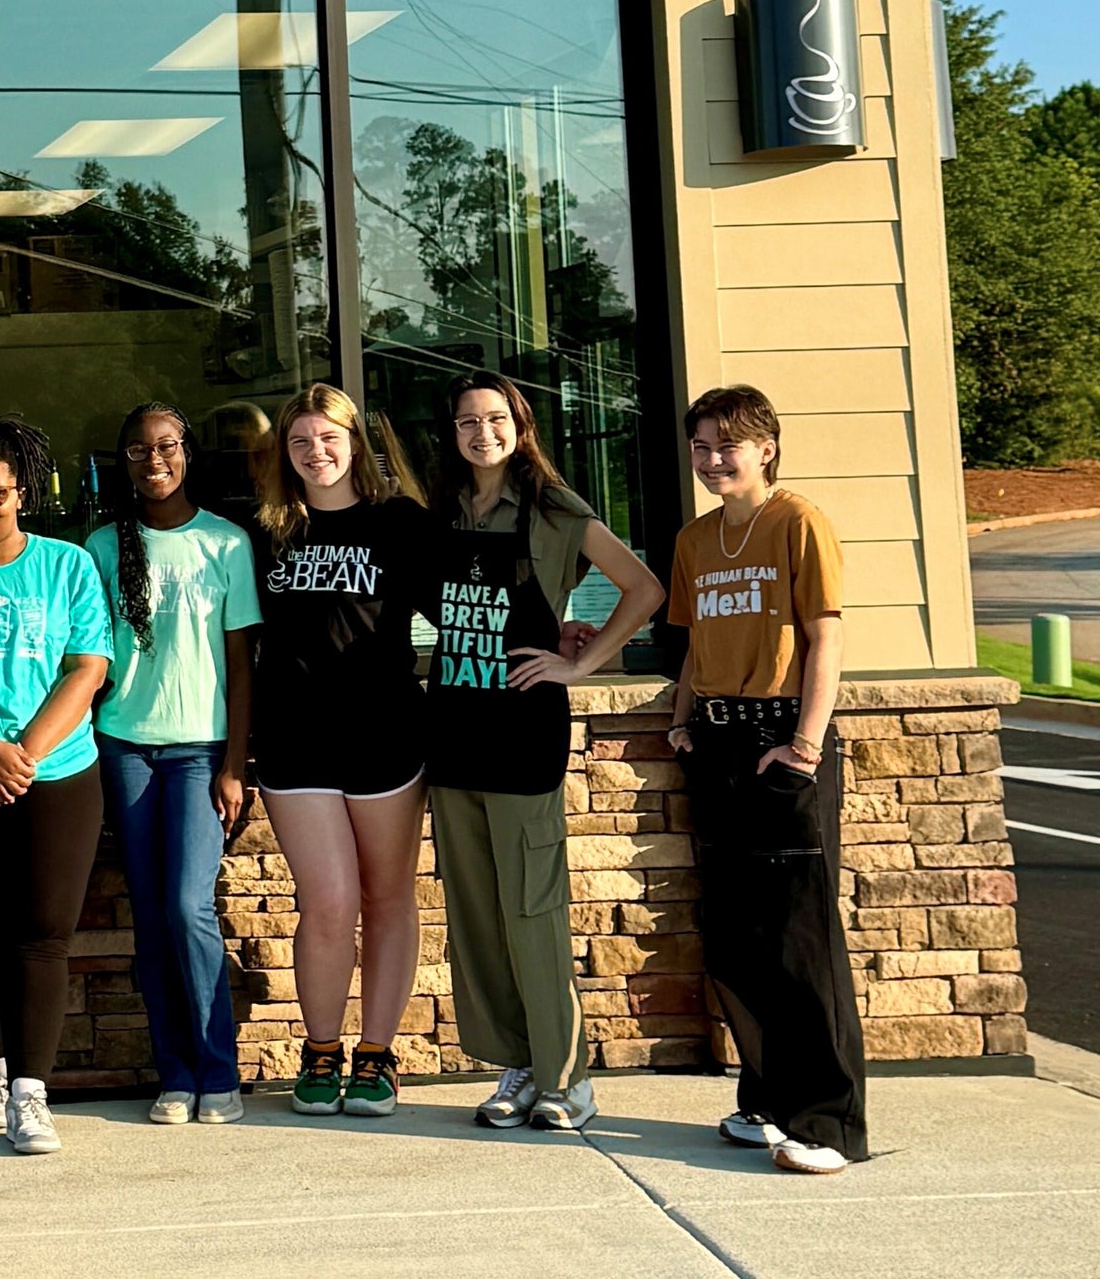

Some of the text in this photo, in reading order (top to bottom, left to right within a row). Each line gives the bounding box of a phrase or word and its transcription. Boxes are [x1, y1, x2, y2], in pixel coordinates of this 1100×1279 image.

[287, 545, 371, 565] the HUMAN
[289, 561, 379, 595] BEAN
[705, 568, 743, 587] HUMAN
[441, 581, 511, 607] HAVE A
[441, 602, 510, 632] BREW
[441, 629, 508, 660] TIFUL
[440, 656, 508, 690] DAY!
